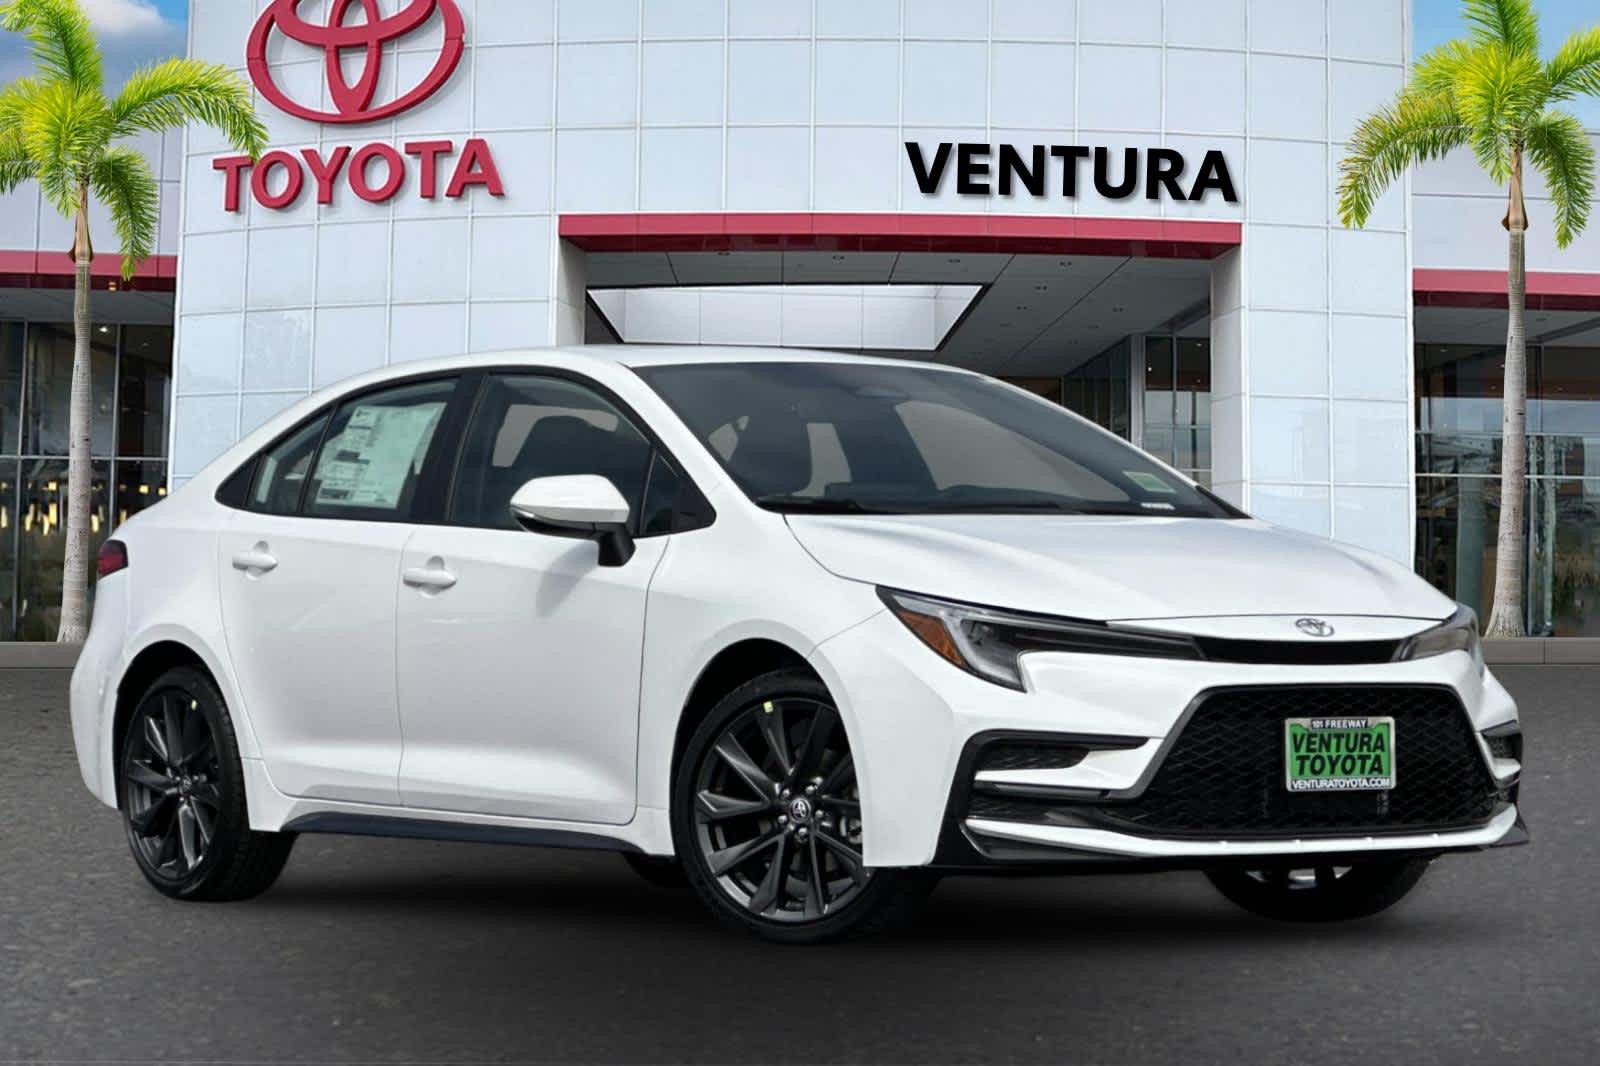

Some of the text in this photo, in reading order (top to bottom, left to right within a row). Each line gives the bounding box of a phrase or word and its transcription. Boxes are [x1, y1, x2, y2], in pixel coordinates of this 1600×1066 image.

[212, 138, 505, 212] TOYOTA
[904, 142, 1239, 203] VENTURA
[1324, 720, 1367, 729] FREEWAY
[1292, 732, 1386, 753] VENTURA
[1295, 754, 1384, 776] TOYOTA
[1292, 778, 1390, 790] VENTURATOYOTA.COM
